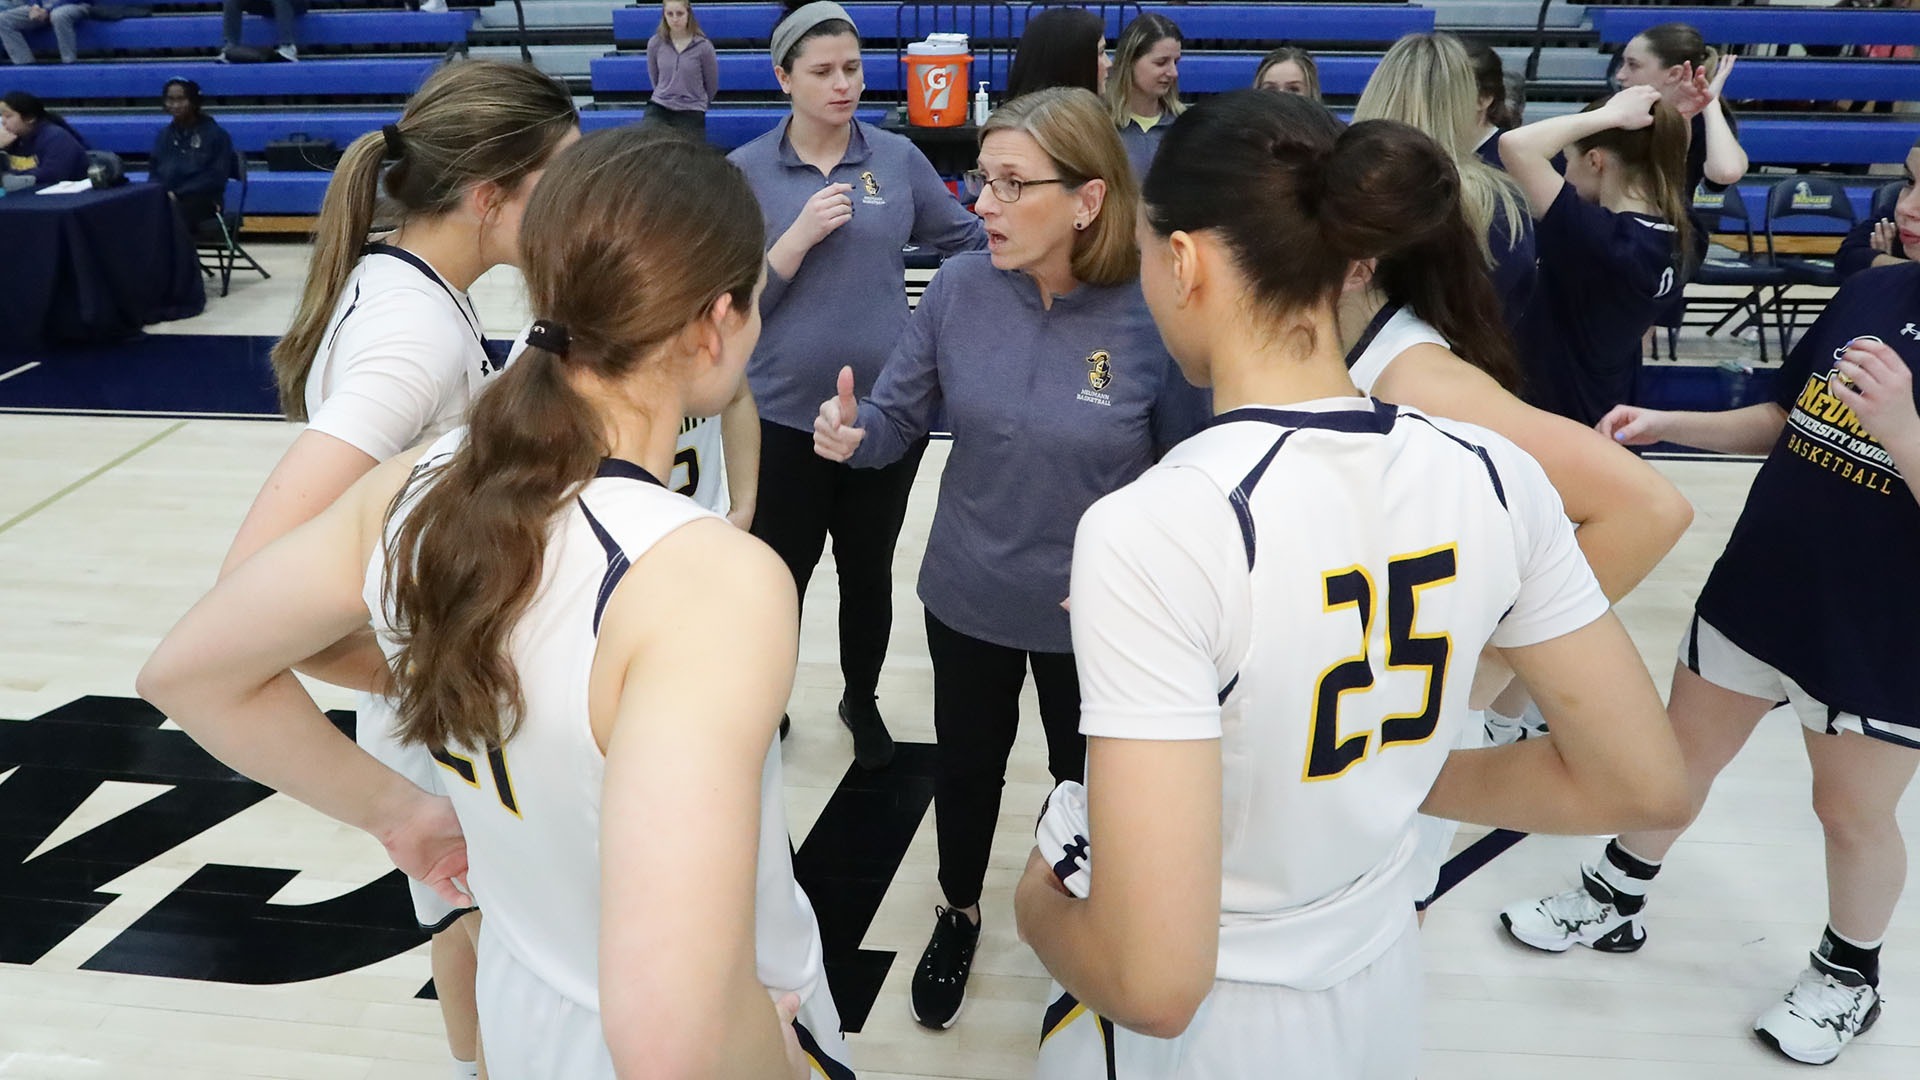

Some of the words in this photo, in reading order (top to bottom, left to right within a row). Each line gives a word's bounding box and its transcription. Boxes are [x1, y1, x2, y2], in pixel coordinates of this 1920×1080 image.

[928, 67, 947, 90] G
[1076, 393, 1112, 407] BASKETBALL
[1797, 378, 1878, 442] NEUM
[1787, 433, 1892, 495] BASKETBALL
[1301, 541, 1458, 783] 25
